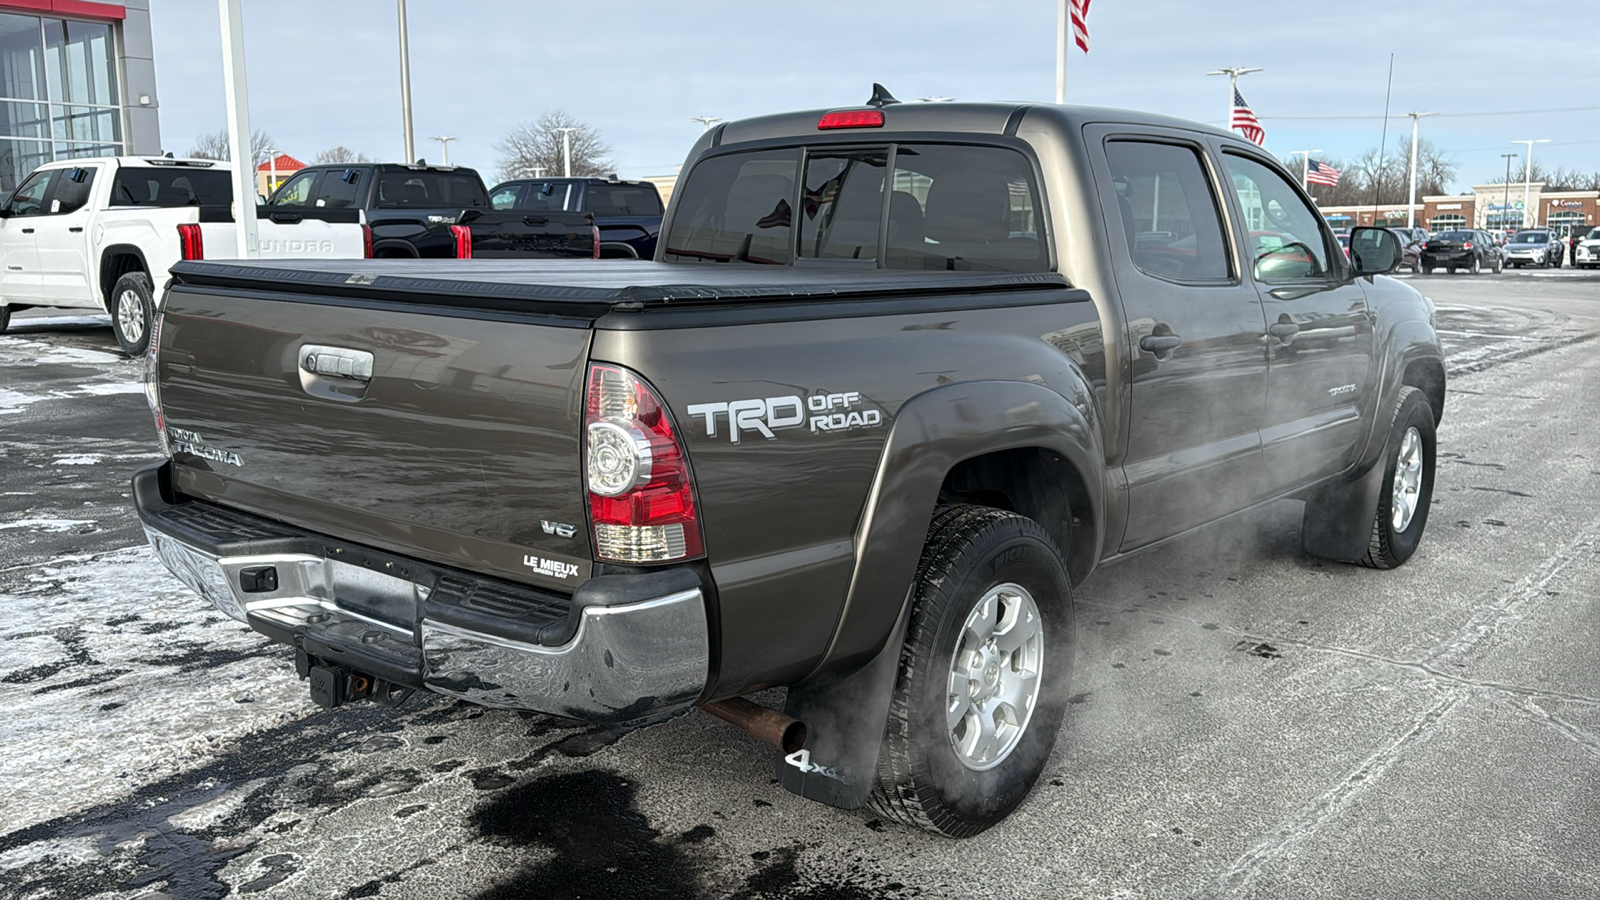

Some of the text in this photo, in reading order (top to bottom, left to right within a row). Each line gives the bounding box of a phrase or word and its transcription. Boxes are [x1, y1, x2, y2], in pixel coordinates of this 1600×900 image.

[258, 240, 335, 253] UNDRA
[687, 391, 862, 445] TRD OFF
[809, 409, 882, 435] ROAD
[168, 426, 203, 443] TOYOTA
[174, 439, 245, 467] TACOMA
[540, 519, 578, 538] V6
[523, 554, 579, 577] LE MIEUX
[533, 567, 568, 579] GREEN BAY
